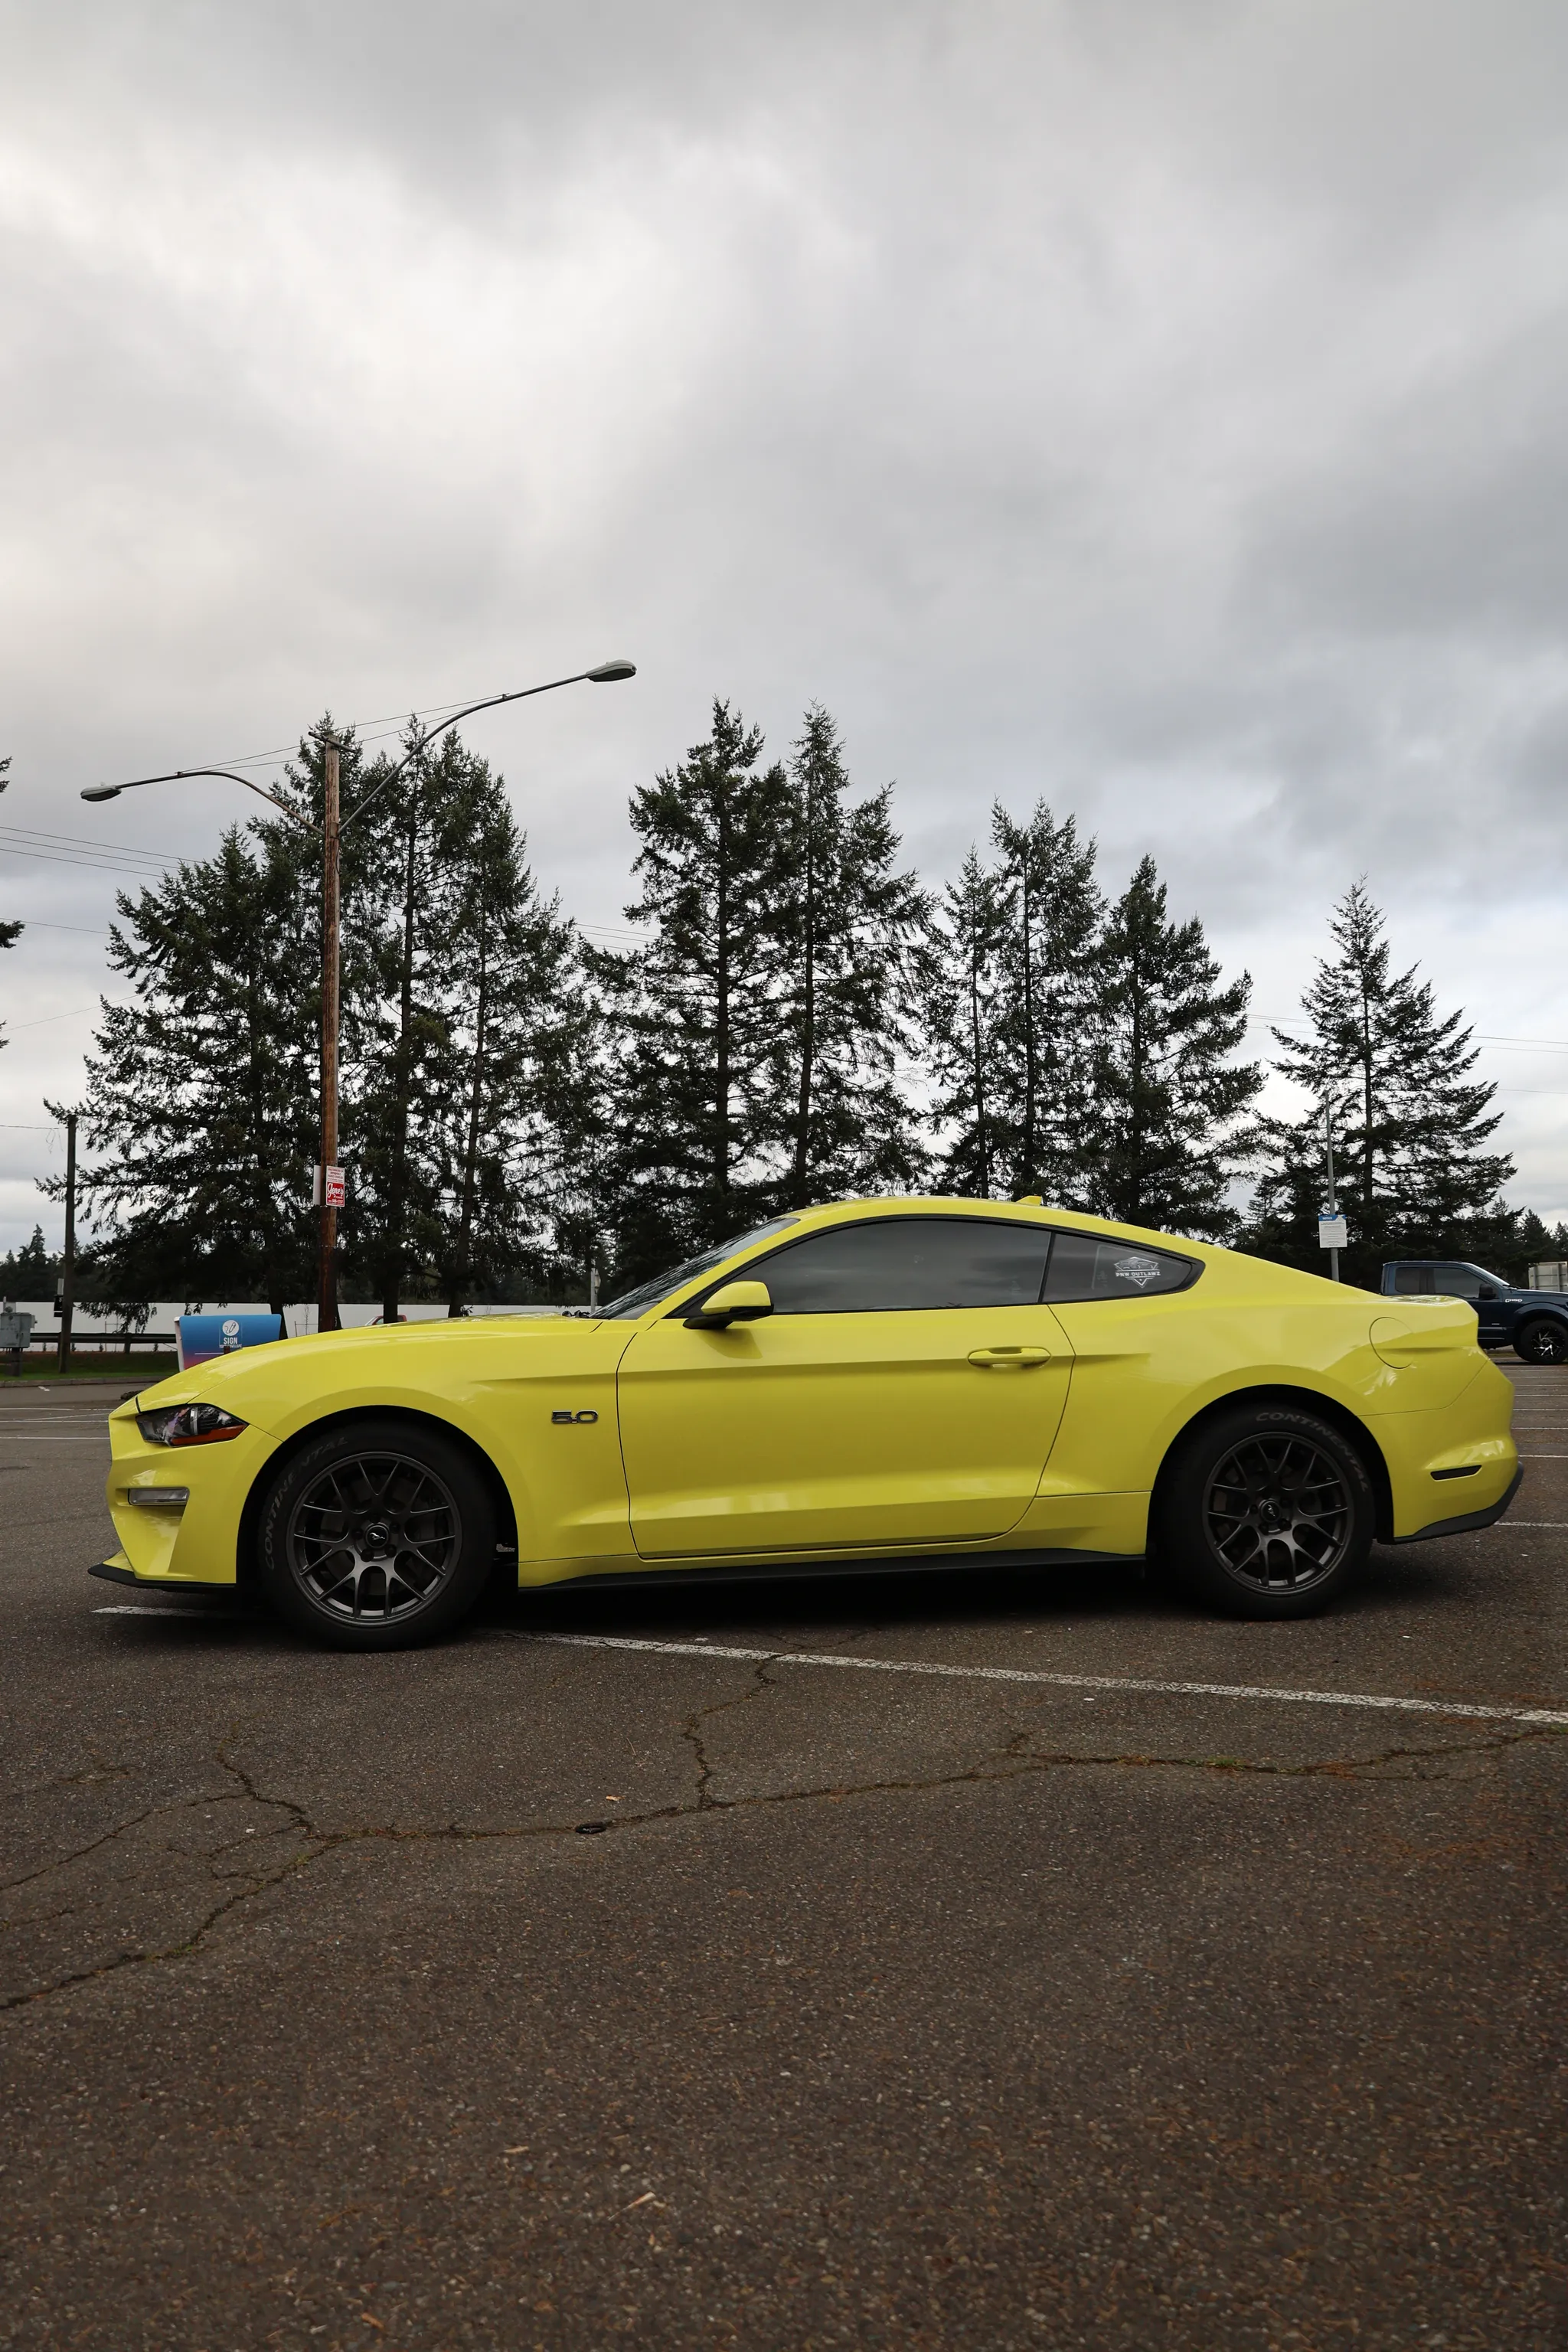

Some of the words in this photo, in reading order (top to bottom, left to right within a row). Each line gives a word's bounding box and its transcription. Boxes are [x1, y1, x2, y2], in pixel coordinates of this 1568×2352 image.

[551, 1410, 599, 1424] 5.0
[1256, 1412, 1370, 1491] CONTINENTAL
[264, 1436, 348, 1570] CONTINENTAL
